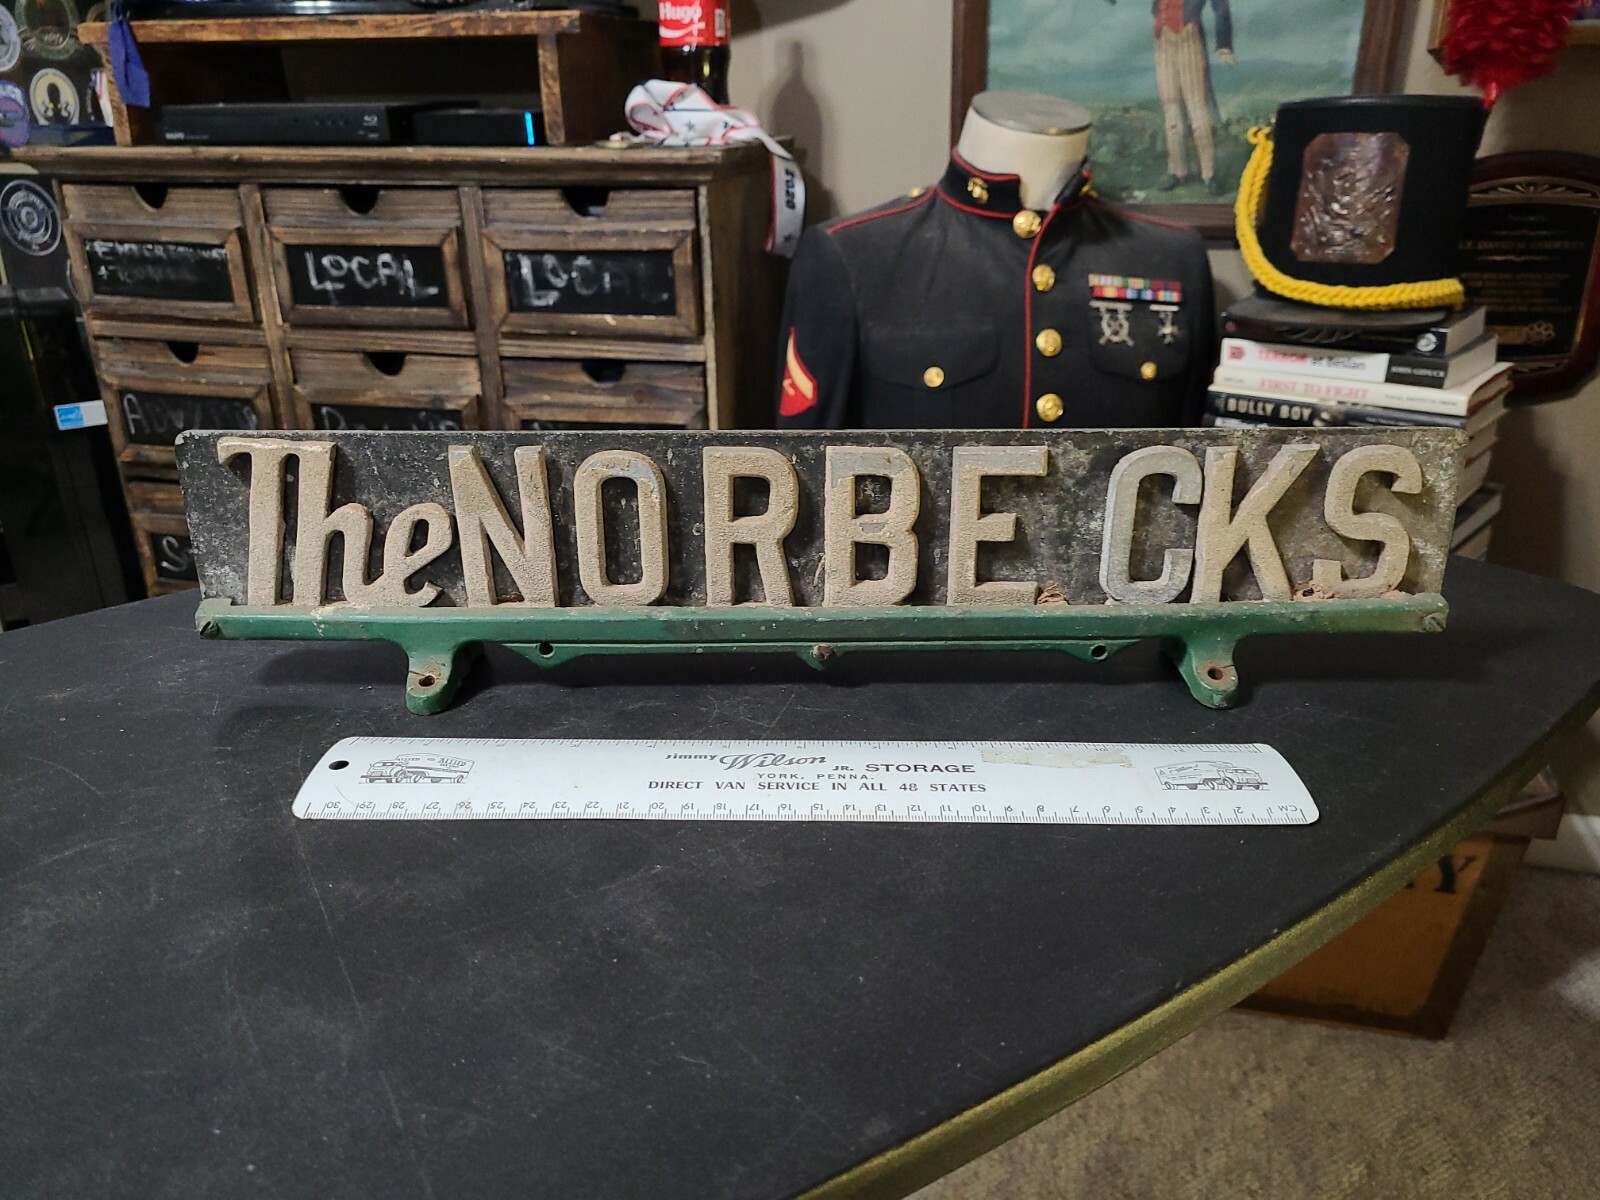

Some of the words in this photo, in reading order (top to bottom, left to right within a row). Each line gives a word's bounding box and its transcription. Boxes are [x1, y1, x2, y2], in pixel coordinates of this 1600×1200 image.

[304, 251, 439, 299] LOCAL
[1260, 378, 1297, 393] FIRST
[1304, 382, 1322, 395] TO
[1325, 384, 1369, 401] FIGHT
[1226, 397, 1275, 417] BULLY
[1279, 404, 1314, 421] BOY
[217, 436, 453, 608] The
[448, 443, 1423, 608] NORBECKS
[720, 752, 827, 771] Wilson
[865, 763, 976, 773] STORAGE
[648, 781, 703, 790] DIRECT
[715, 781, 746, 790] VAN
[758, 782, 820, 791] SERVICE
[831, 783, 847, 791] IN
[858, 783, 888, 792] ALL
[898, 783, 918, 792] 48
[929, 783, 987, 793] STATES
[749, 803, 760, 811] 17
[813, 803, 824, 811] 15
